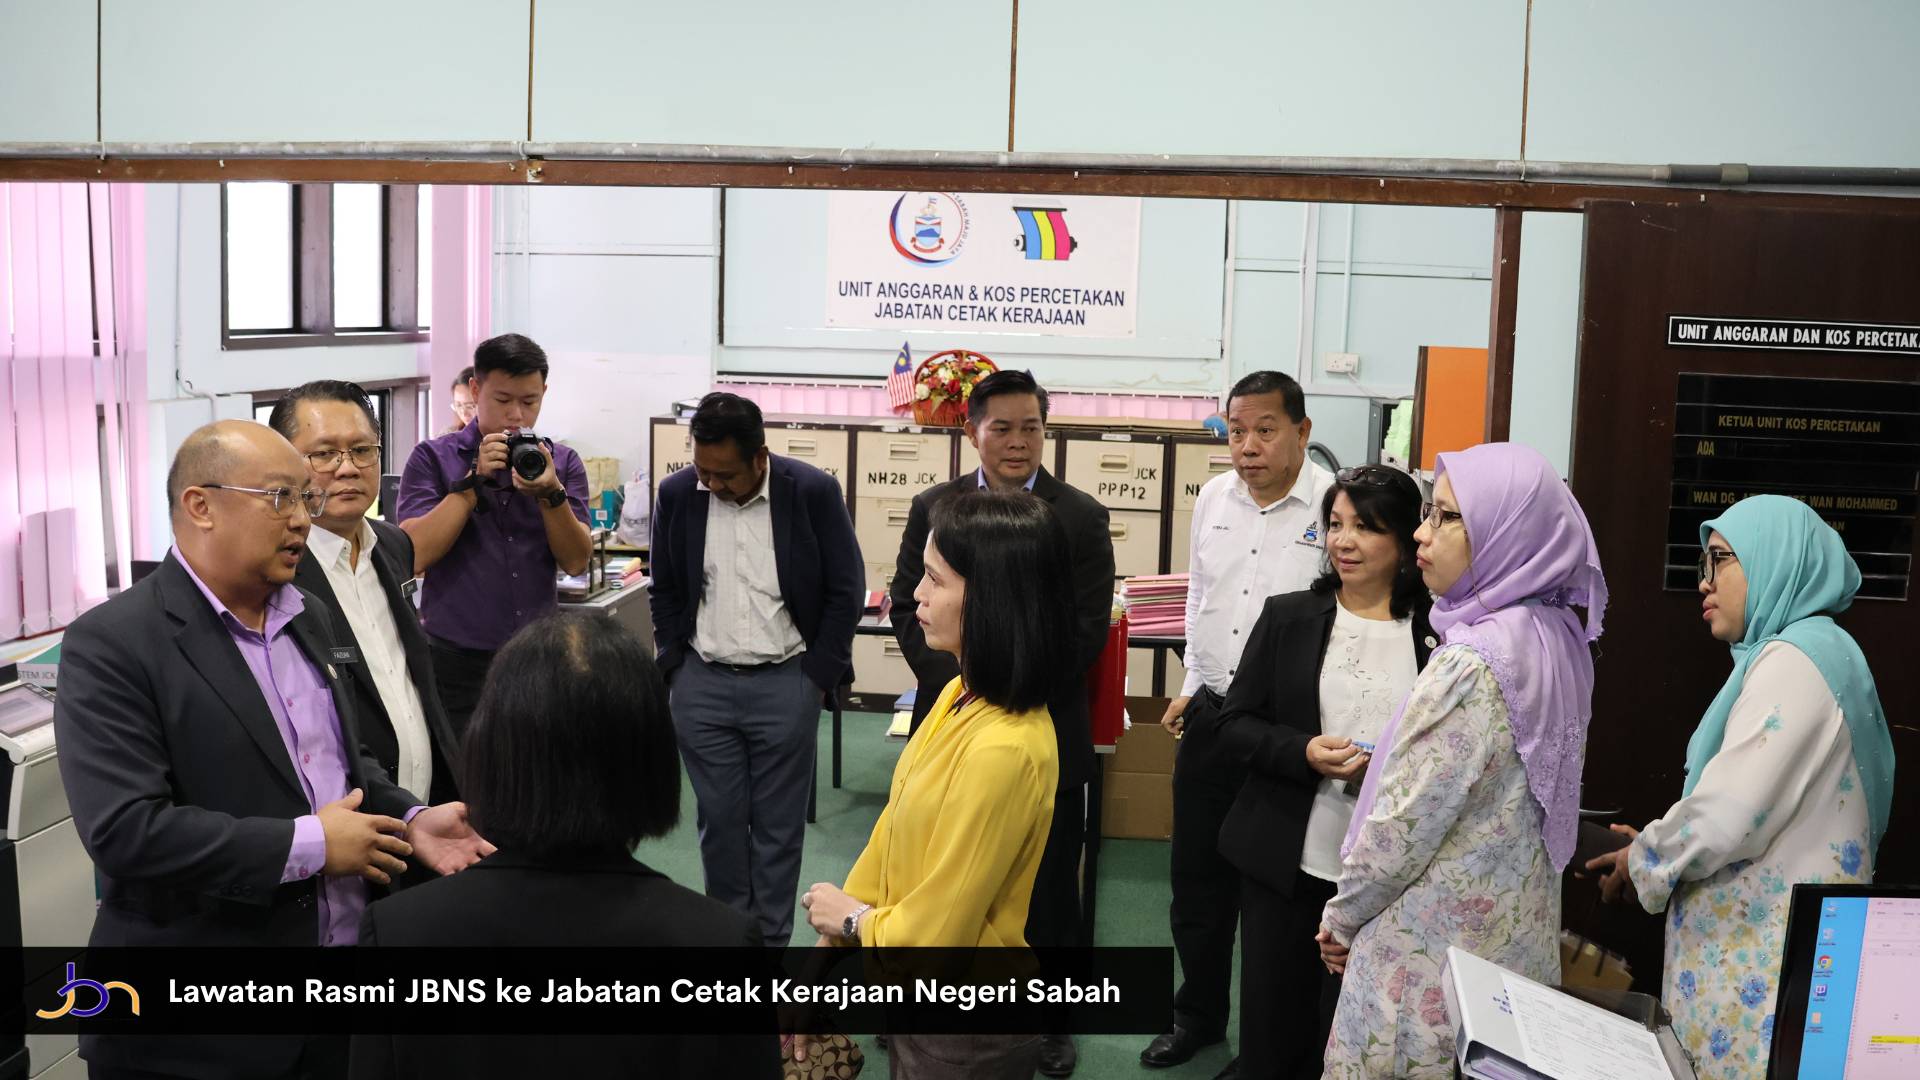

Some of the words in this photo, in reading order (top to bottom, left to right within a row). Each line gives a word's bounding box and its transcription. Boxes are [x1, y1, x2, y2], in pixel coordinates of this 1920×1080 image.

[838, 281, 872, 297] UNIT
[876, 282, 963, 301] ANGGARAN
[968, 285, 978, 301] &
[984, 286, 1015, 302] KOS
[1020, 287, 1125, 306] PERCETAKAN
[874, 302, 943, 320] JABATAN
[948, 305, 998, 323] CETAK
[1002, 307, 1086, 326] KERAJAAN
[1678, 324, 1708, 340] UNIT
[1713, 325, 1788, 343] ANGGARAN
[1793, 328, 1820, 344] DAN
[1825, 330, 1850, 346] KOS
[1718, 415, 1754, 428] KETUA
[1757, 417, 1783, 429] UNIT
[1785, 418, 1807, 430] KOS
[1810, 419, 1881, 433] PERCETAKAN
[1697, 440, 1715, 457] ADA
[868, 472, 907, 485] NH28
[914, 473, 937, 484] JCK
[1135, 467, 1157, 480] JCK
[1693, 491, 1717, 504] WAN
[1809, 495, 1833, 509] WAN
[1836, 496, 1898, 511] MOHAMMED
